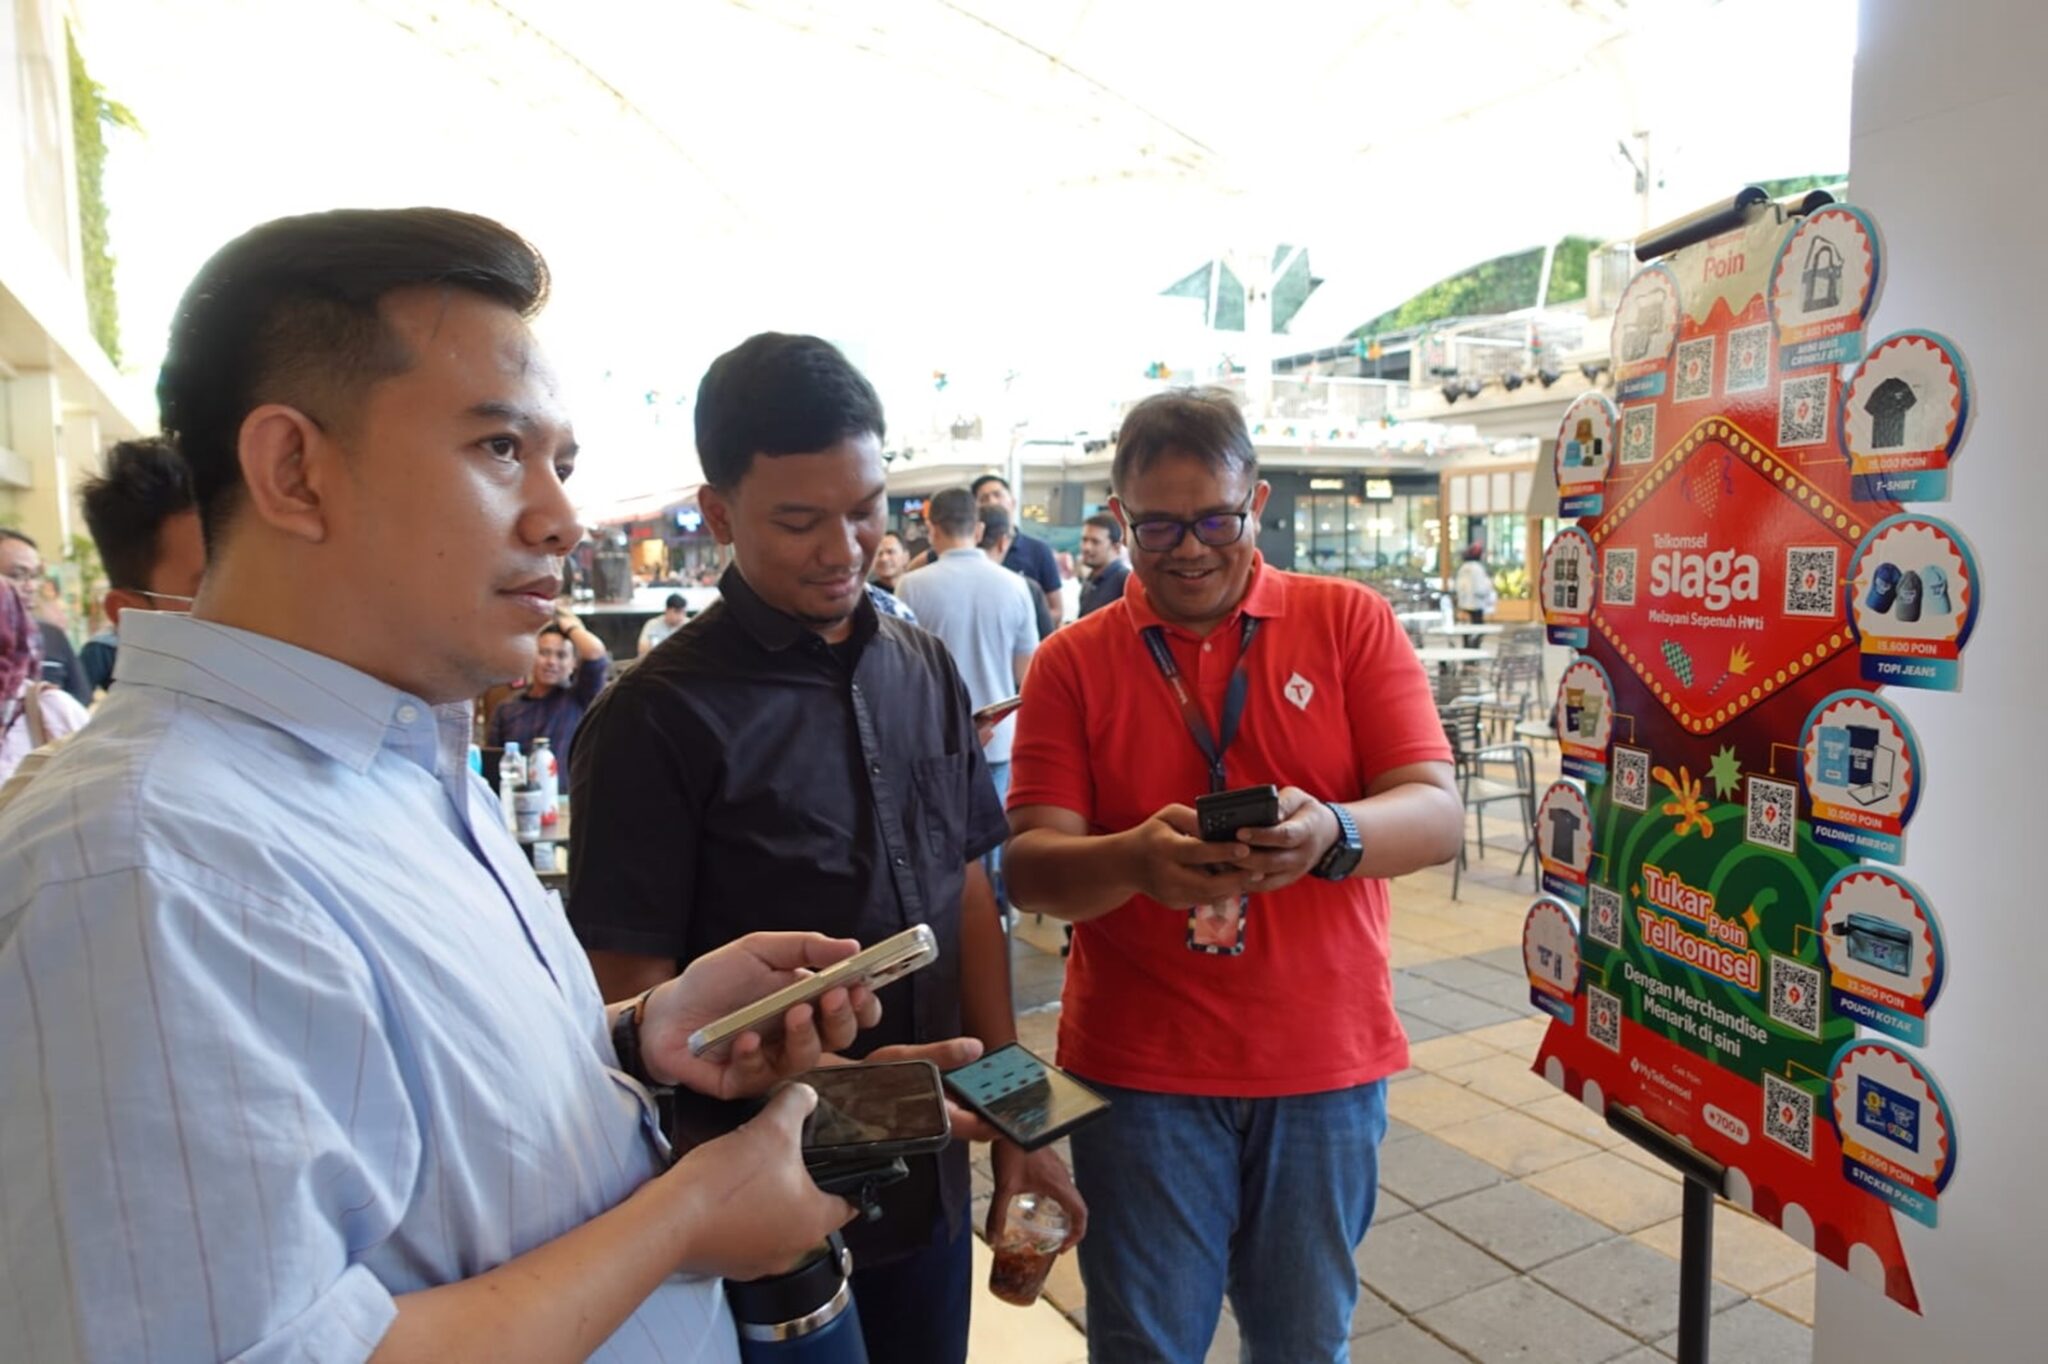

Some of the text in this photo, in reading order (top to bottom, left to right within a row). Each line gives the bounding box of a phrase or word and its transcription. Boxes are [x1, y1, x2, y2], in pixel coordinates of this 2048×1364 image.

[1703, 250, 1745, 283] Poin
[1900, 456, 1926, 468] POIN
[1876, 480, 1918, 492] T-SHIRT
[1652, 532, 1707, 549] Telkomsel
[1648, 609, 1689, 627] Melayani
[1691, 612, 1737, 629] Sepenuh
[1911, 643, 1937, 655] POIN
[1877, 662, 1936, 677] TOPI JEANS
[1858, 814, 1883, 829] POIN
[1815, 825, 1895, 853] FOLDING MIRROR
[1643, 866, 1713, 920] Tukar
[1707, 913, 1747, 948] Poin
[1639, 909, 1760, 989] Telkomsel
[1624, 961, 1769, 1045] Dengan Merchandise
[1880, 991, 1905, 1009] POIN
[1643, 994, 1741, 1058] Menarik di sini
[1840, 997, 1912, 1032] POUCH KOTAK
[1888, 1165, 1915, 1186] POIN
[1852, 1167, 1925, 1212] STICKER PACK
